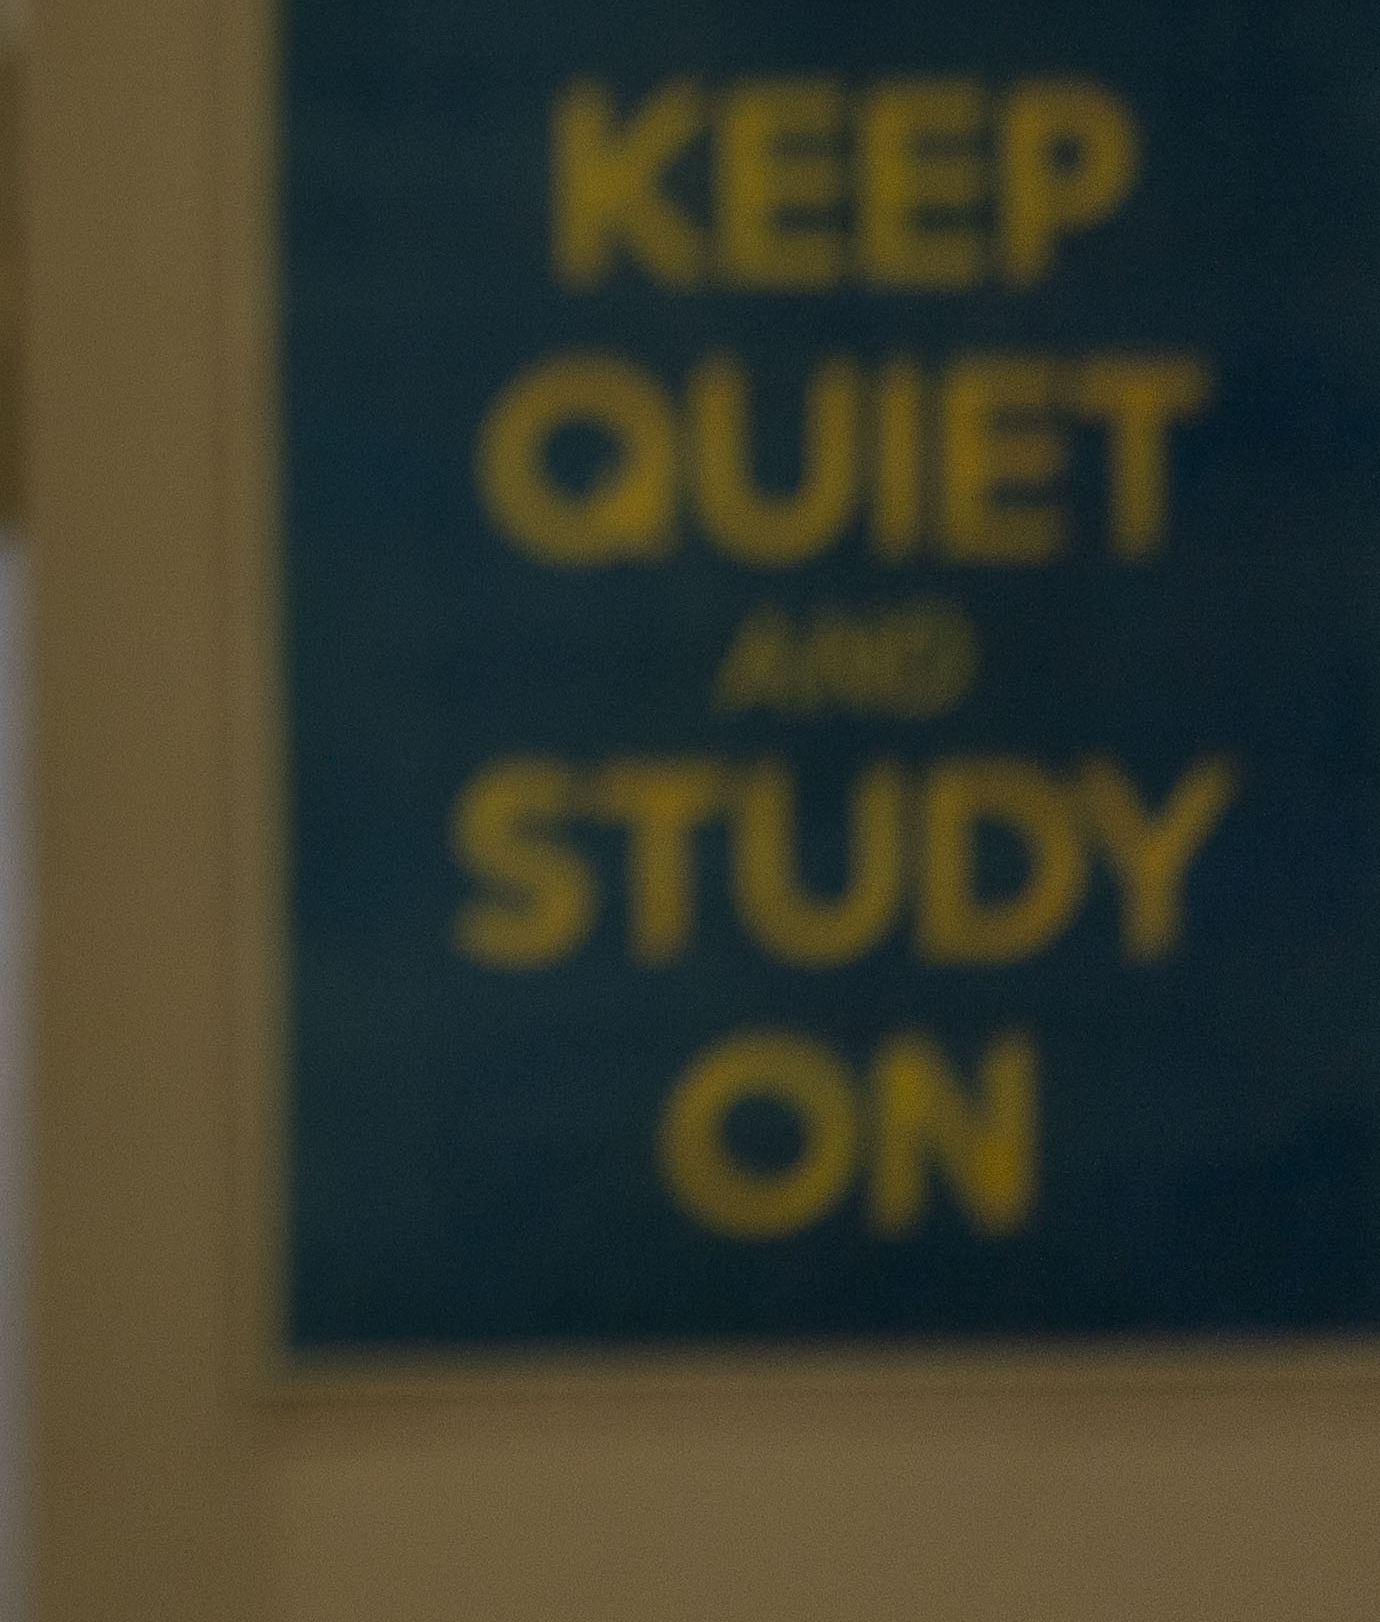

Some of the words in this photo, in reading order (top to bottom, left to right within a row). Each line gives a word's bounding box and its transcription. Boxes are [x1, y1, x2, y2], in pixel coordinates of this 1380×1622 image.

[548, 77, 1140, 290] KEEP
[475, 350, 1208, 565] QUIET
[715, 603, 980, 716] AND
[452, 756, 1232, 970] STUDY
[657, 1030, 1045, 1238] ON
